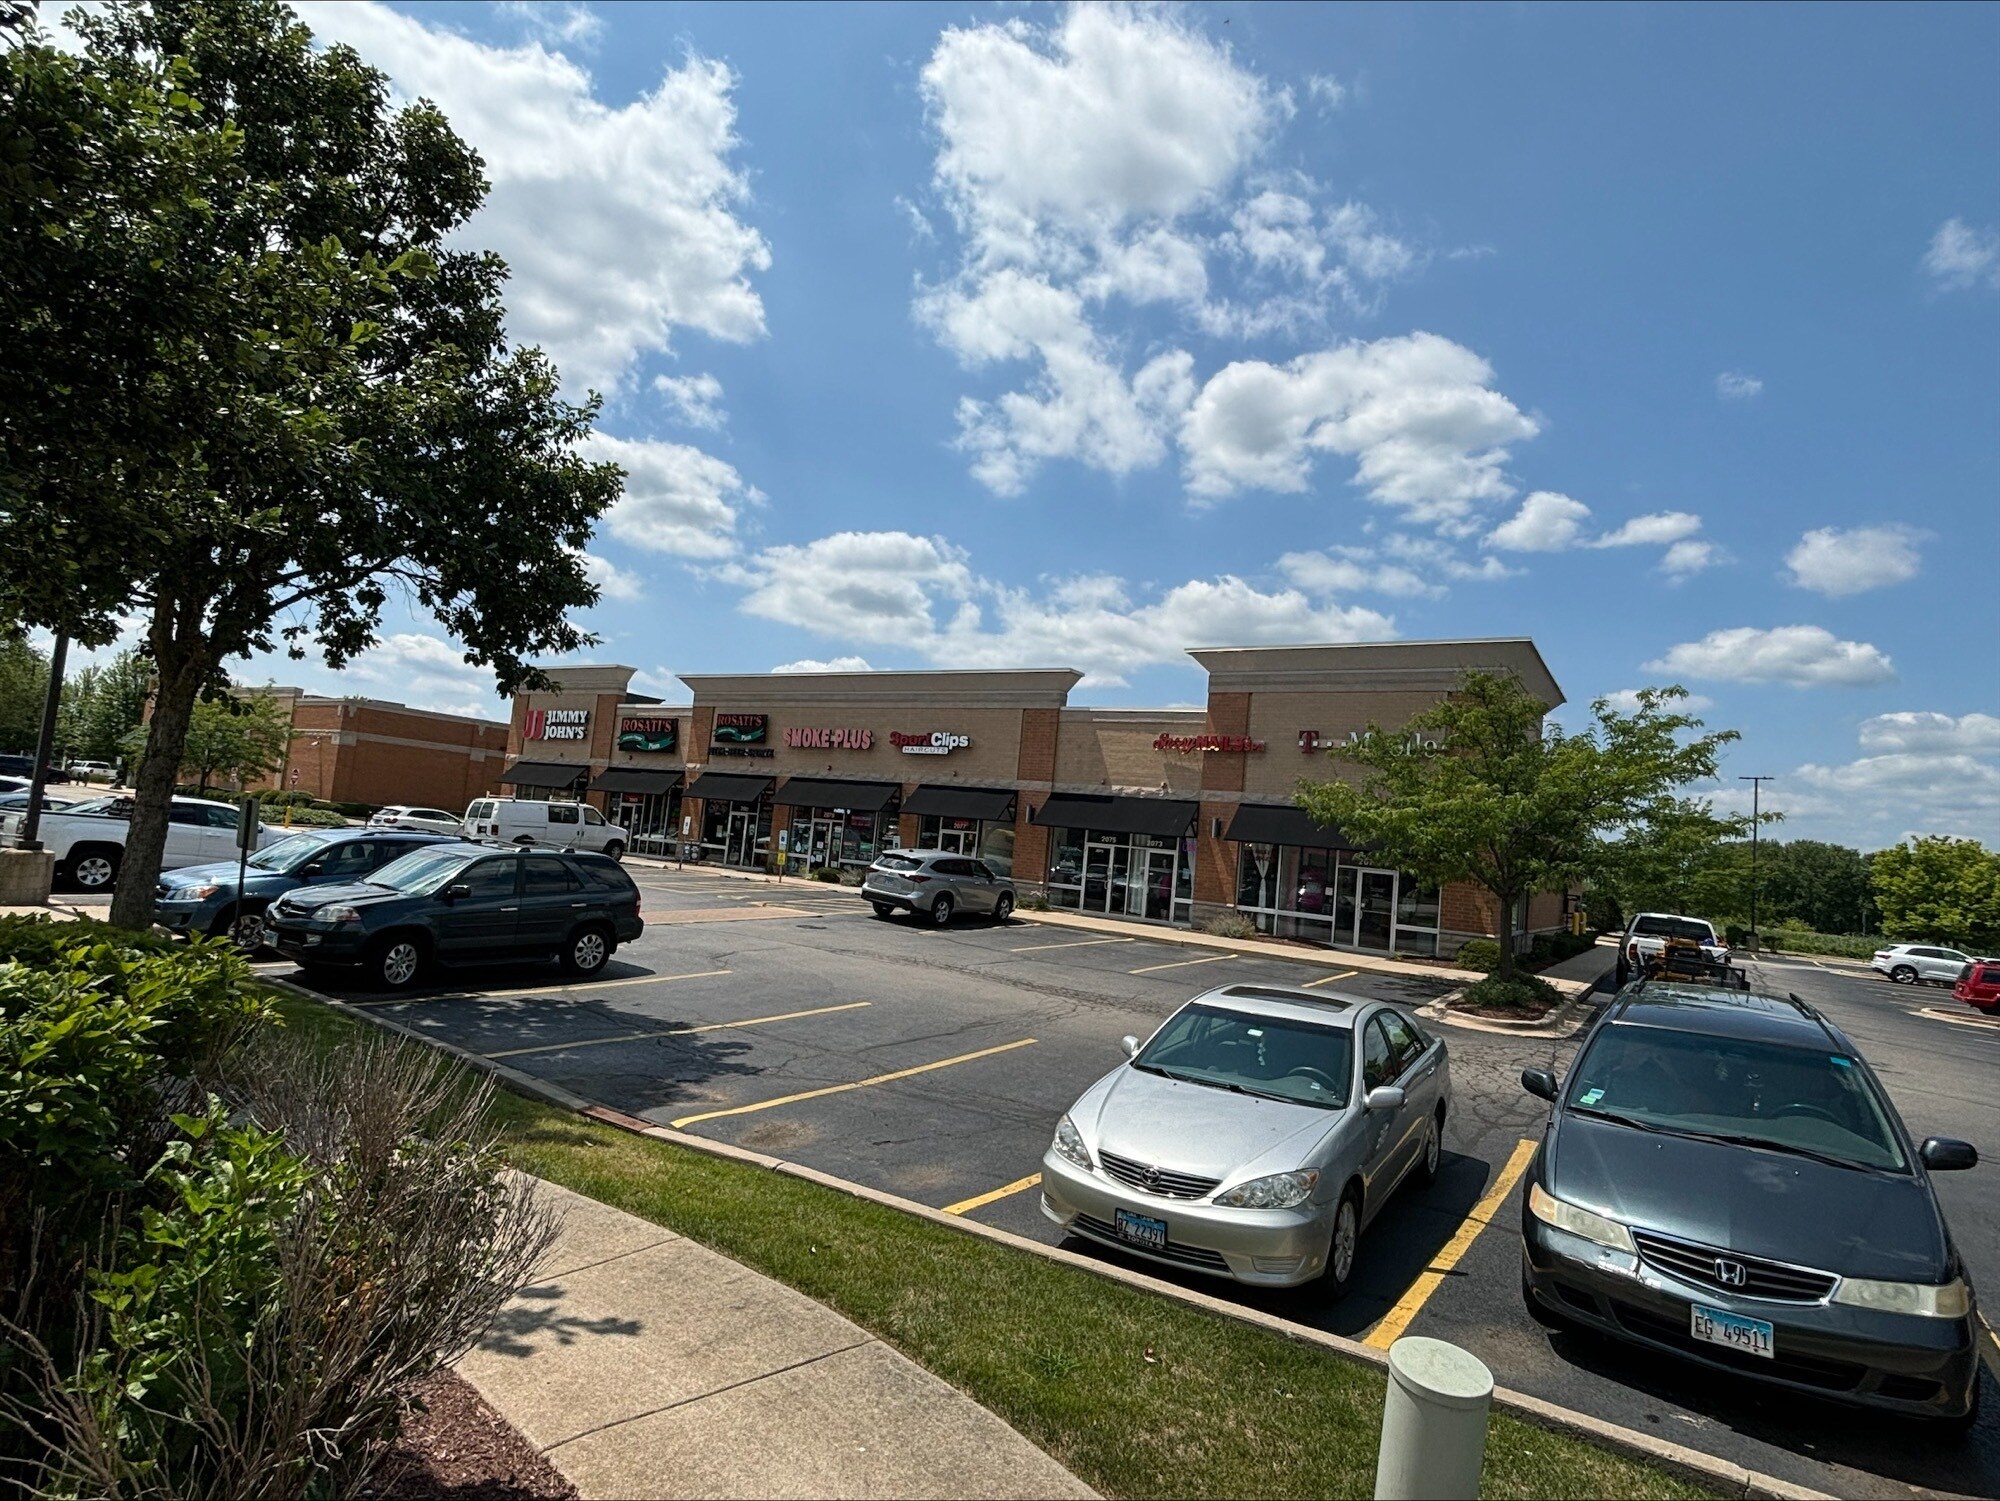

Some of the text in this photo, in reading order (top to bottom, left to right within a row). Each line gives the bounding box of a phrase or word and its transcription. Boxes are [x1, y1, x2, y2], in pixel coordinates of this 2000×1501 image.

[546, 710, 588, 725] JIMMY
[717, 715, 763, 727] ROSATI'S
[543, 725, 585, 740] JOHN'S
[622, 719, 673, 733] ROSATI'S
[782, 727, 872, 750] SMOKE PLUS
[903, 746, 947, 754] HAIRCUTS
[1135, 1222, 1164, 1243] 22397
[1695, 1315, 1770, 1352] EG 49511
